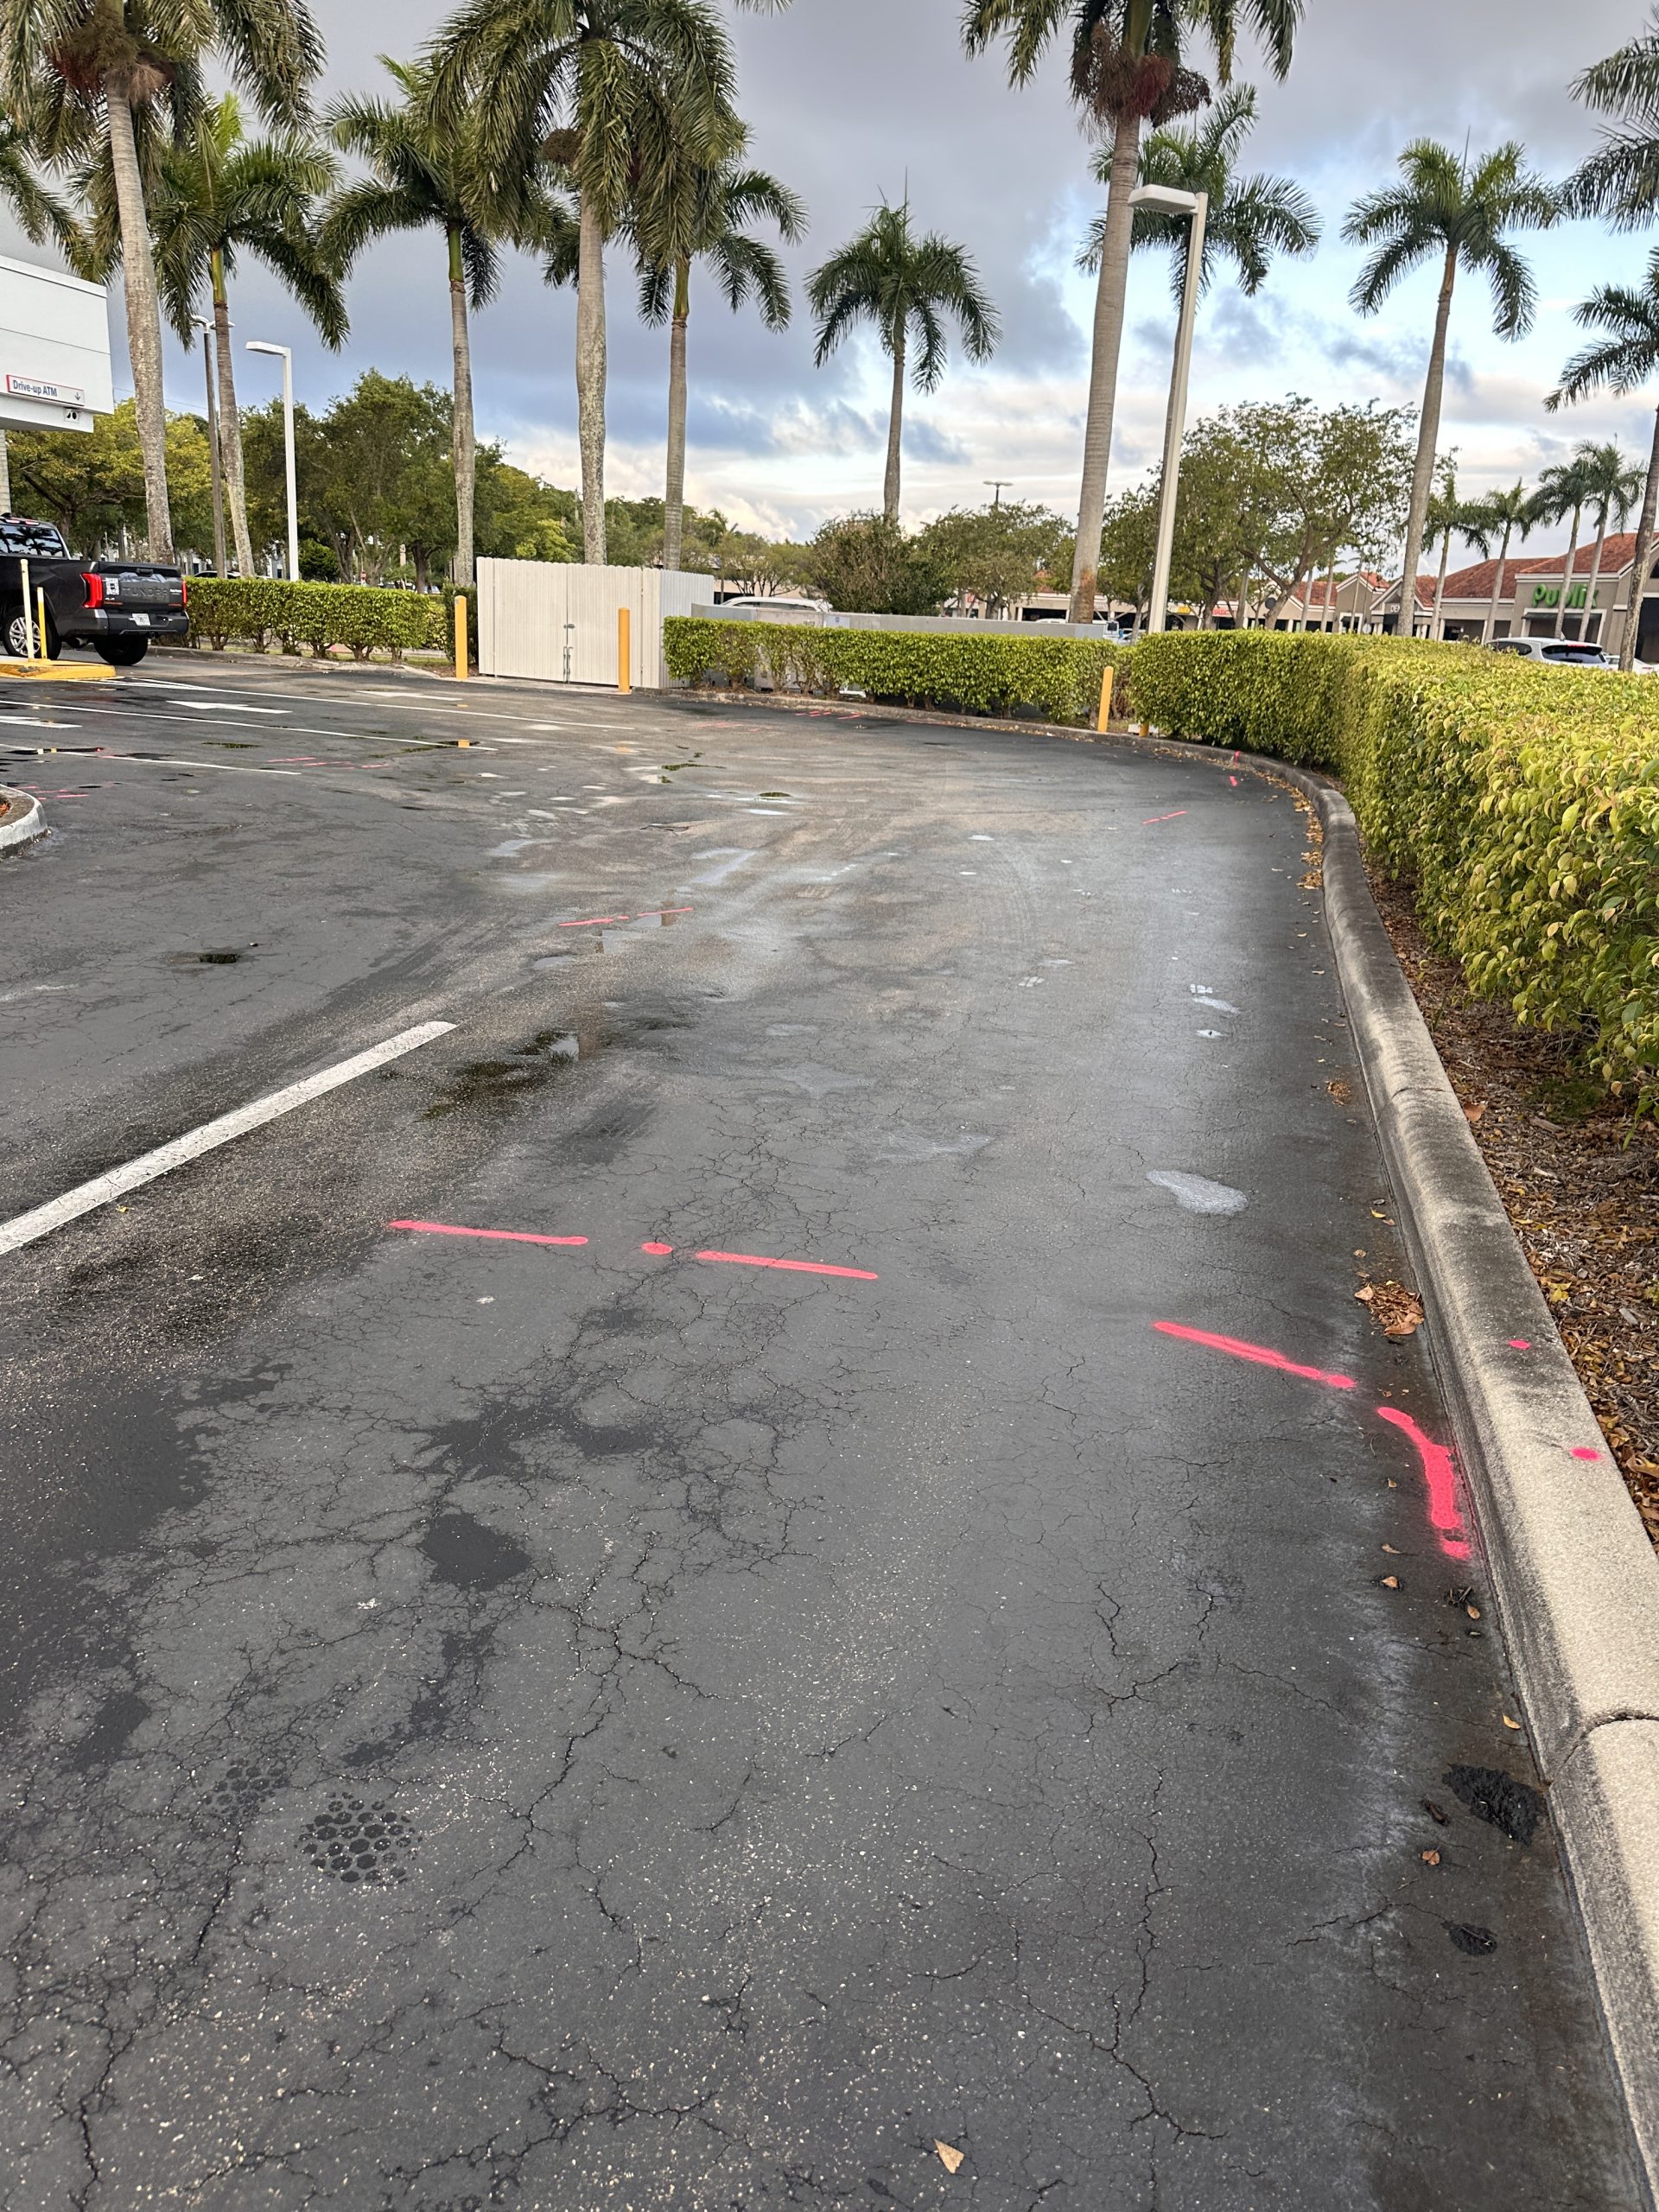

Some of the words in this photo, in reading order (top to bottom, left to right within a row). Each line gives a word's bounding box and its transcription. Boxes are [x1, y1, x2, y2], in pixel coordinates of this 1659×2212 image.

[13, 380, 41, 395] Drive-up
[42, 385, 57, 397] ATM
[122, 586, 168, 597] TUNDRA
